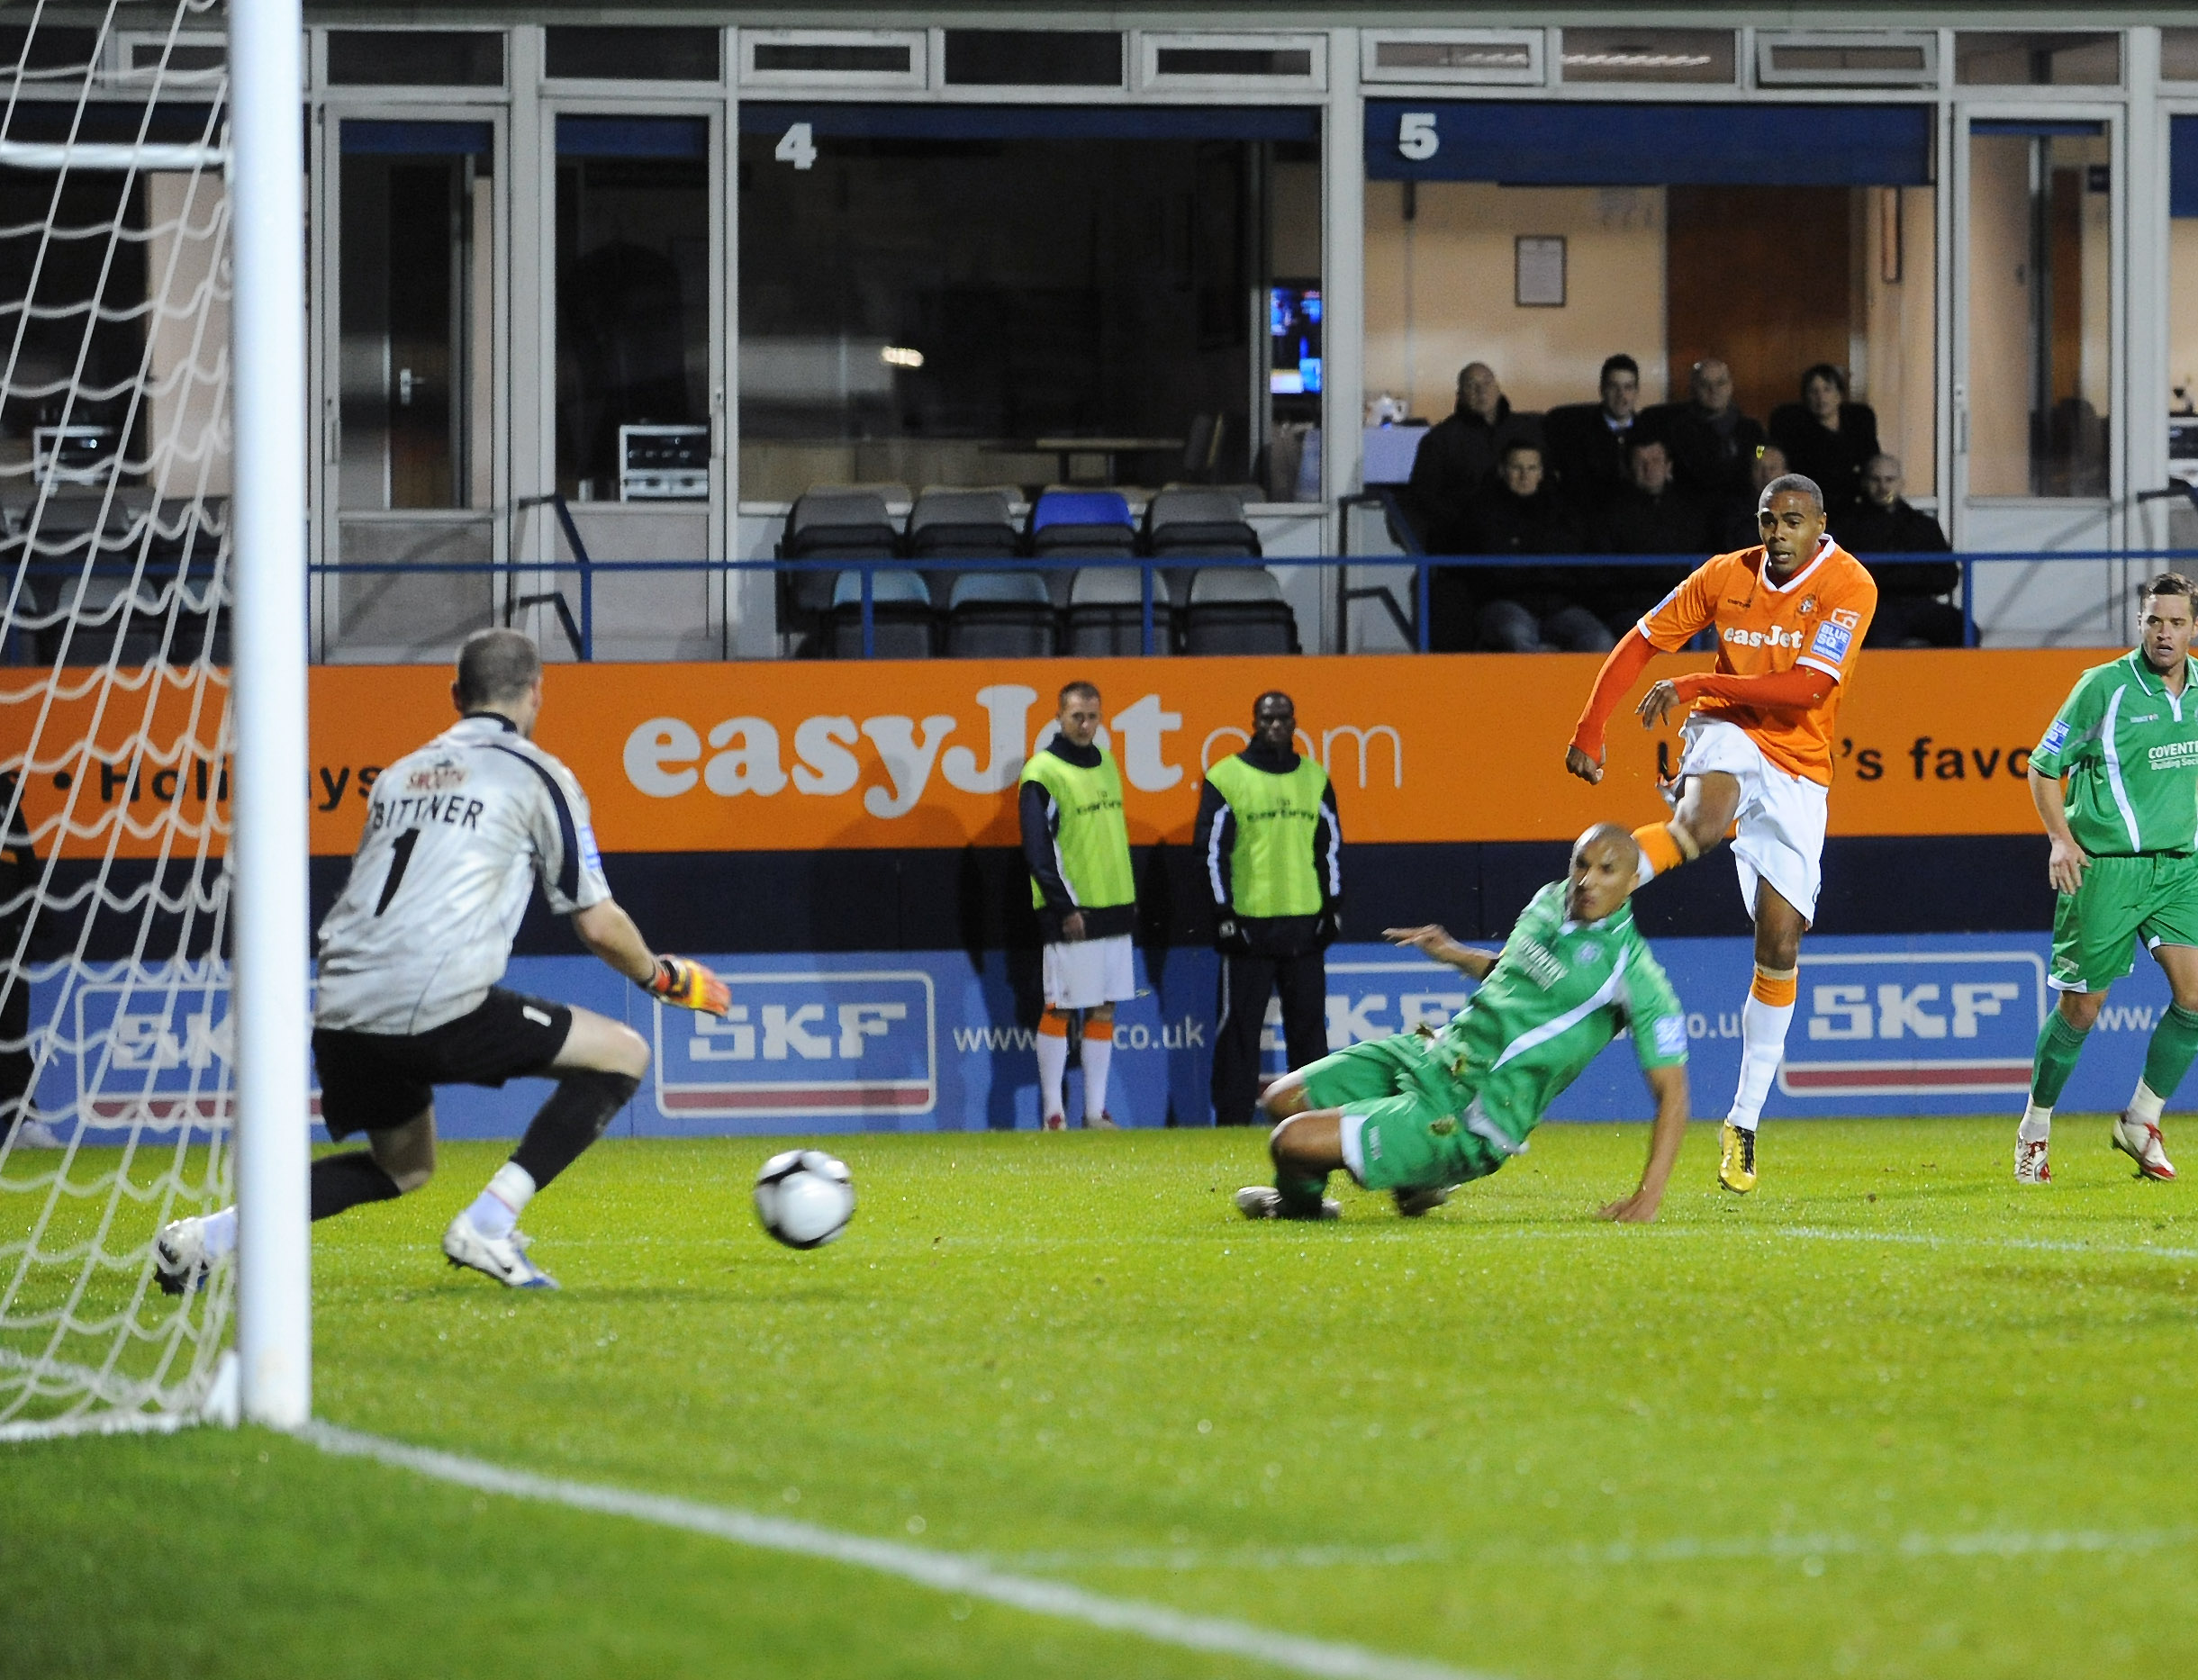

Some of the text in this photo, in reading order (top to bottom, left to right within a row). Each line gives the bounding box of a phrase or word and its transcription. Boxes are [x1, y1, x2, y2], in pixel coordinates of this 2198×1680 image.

[775, 122, 817, 169] 4
[1399, 113, 1439, 159] 5
[1723, 625, 1804, 649] easJet
[1821, 625, 1851, 644] BLUE
[623, 683, 1403, 819] easyJt.cm
[1909, 735, 2037, 781] favo
[100, 757, 385, 813] Holiys
[373, 794, 484, 830] BITTNER
[371, 827, 421, 917] 1
[522, 1005, 552, 1026] 1
[689, 1002, 906, 1061] SKF
[1808, 981, 2019, 1040] SKF
[112, 1013, 238, 1070] SK
